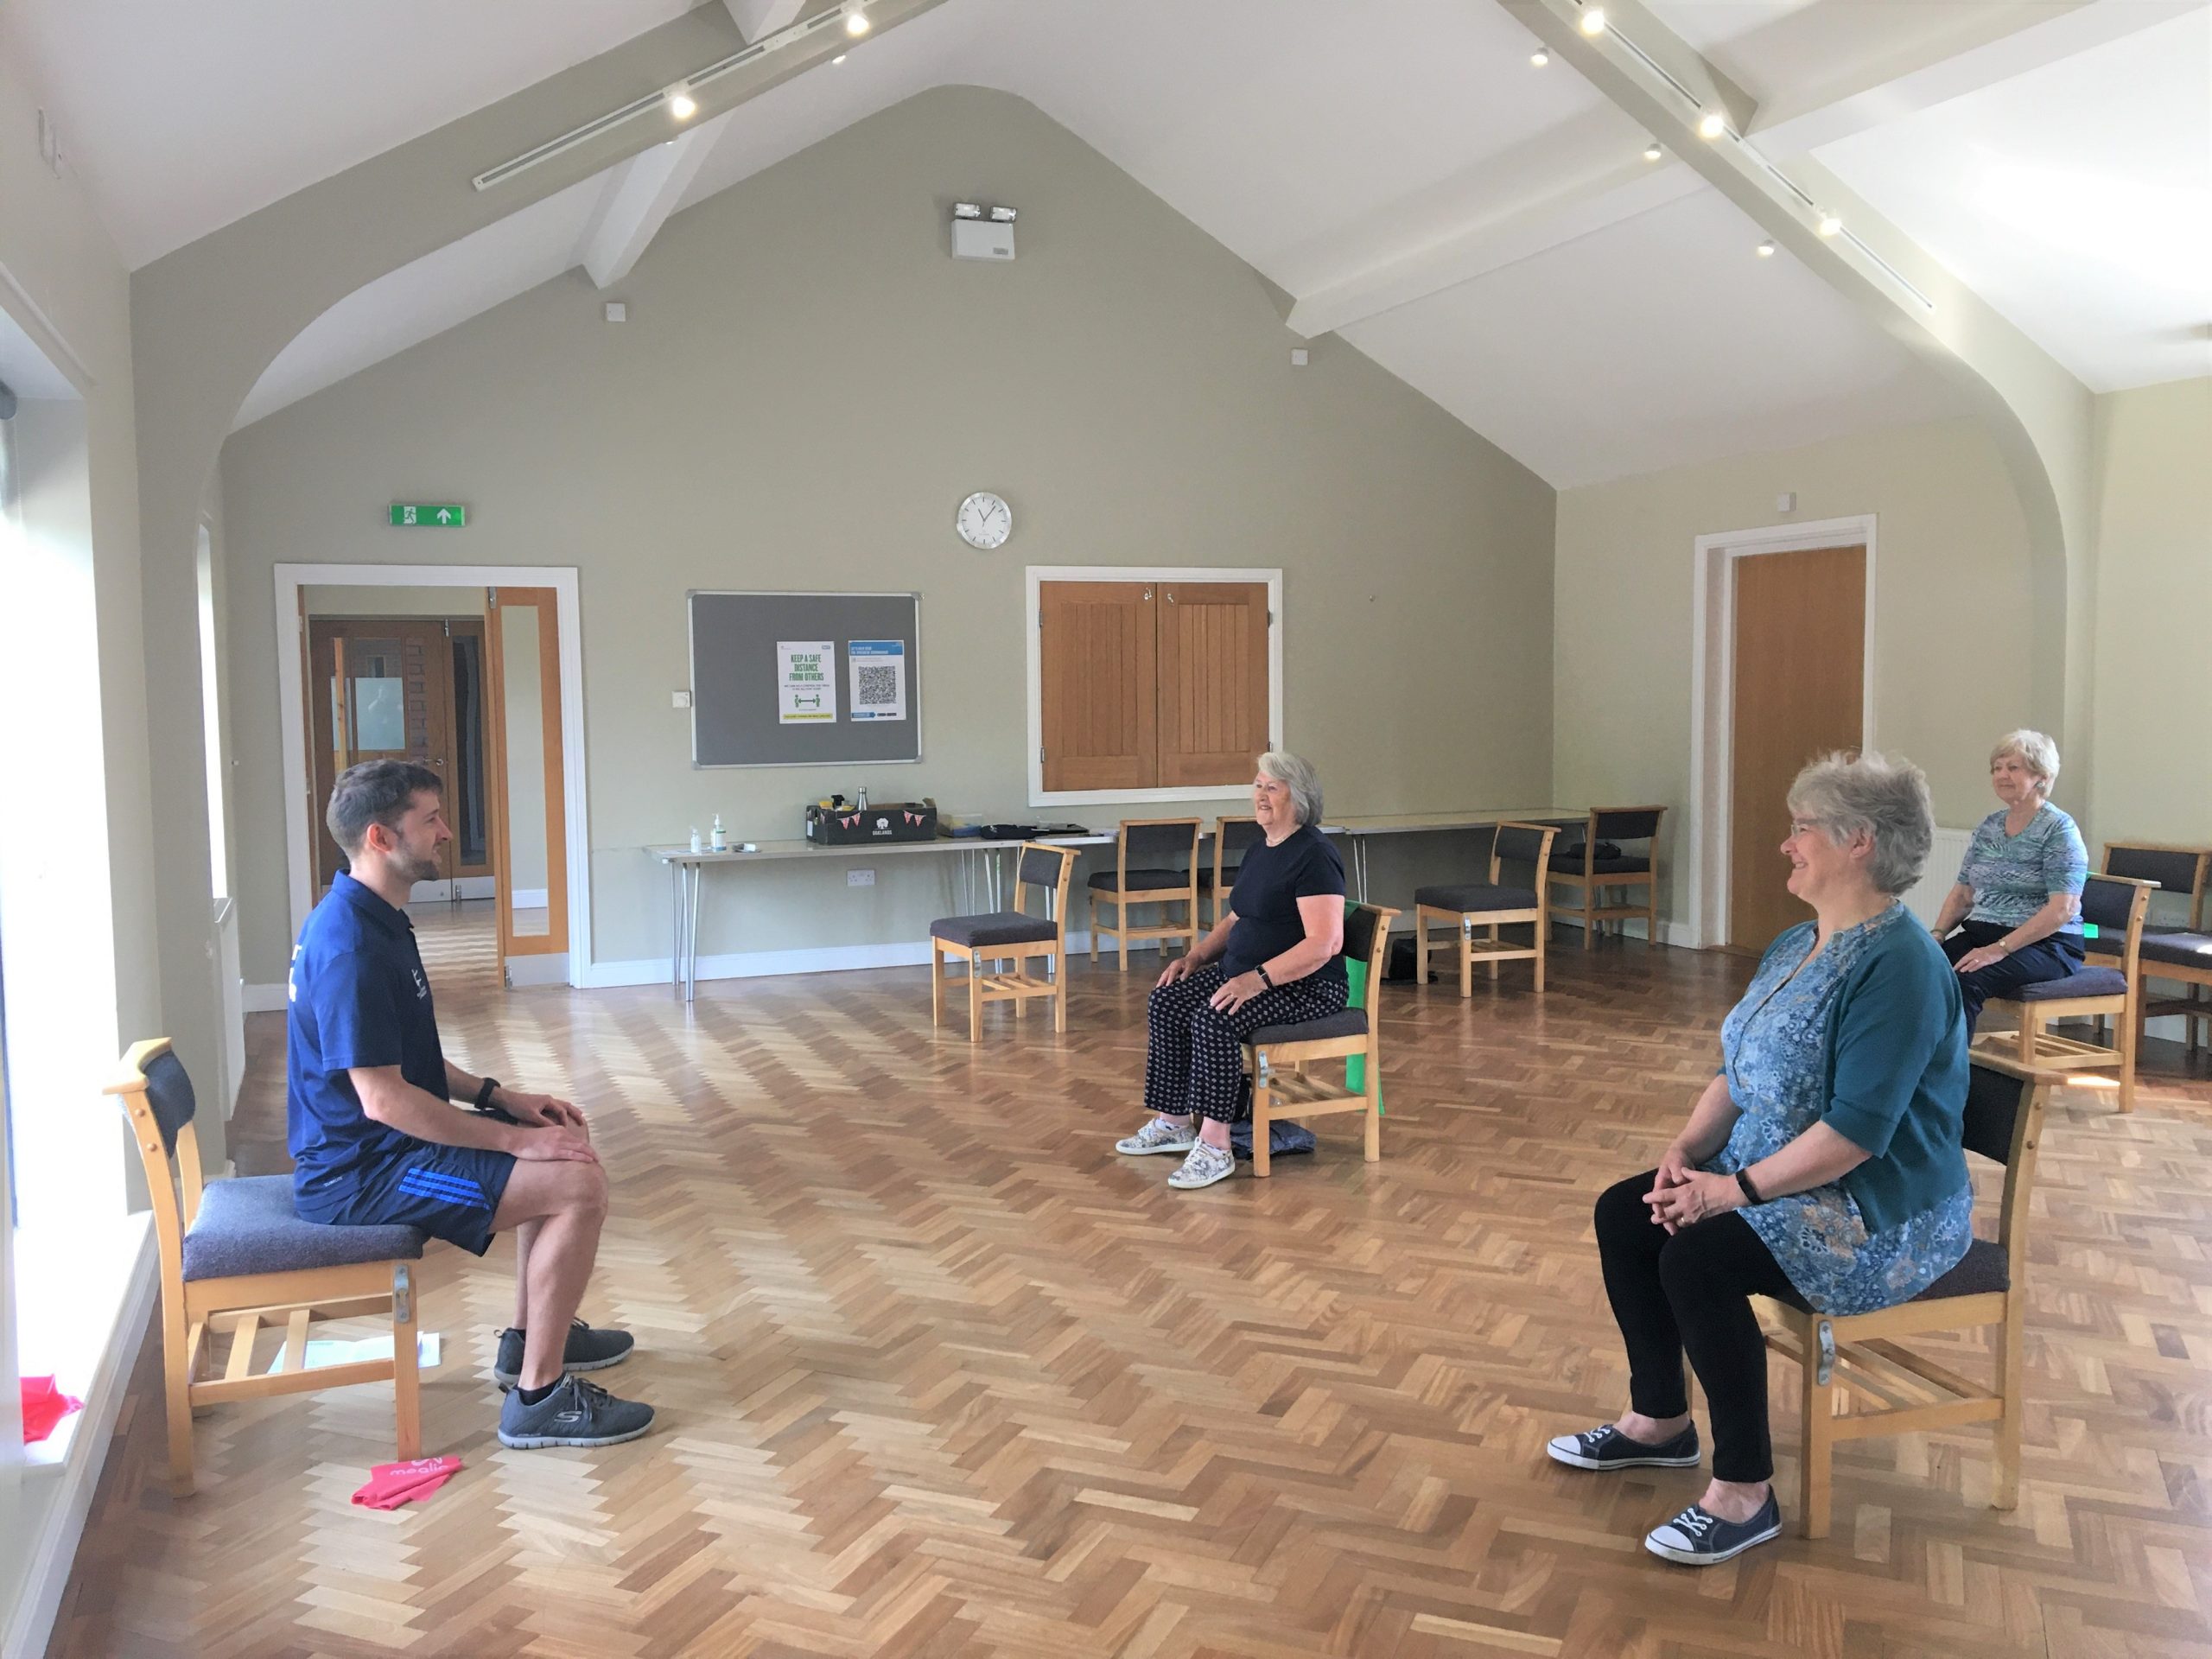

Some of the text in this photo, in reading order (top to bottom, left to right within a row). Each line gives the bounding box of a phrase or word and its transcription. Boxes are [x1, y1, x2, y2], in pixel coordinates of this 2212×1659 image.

[791, 654, 803, 663] KEEP
[809, 654, 822, 663] SAFE
[794, 663, 818, 671] DISTANCE
[789, 672, 823, 681] FROM OTHERS
